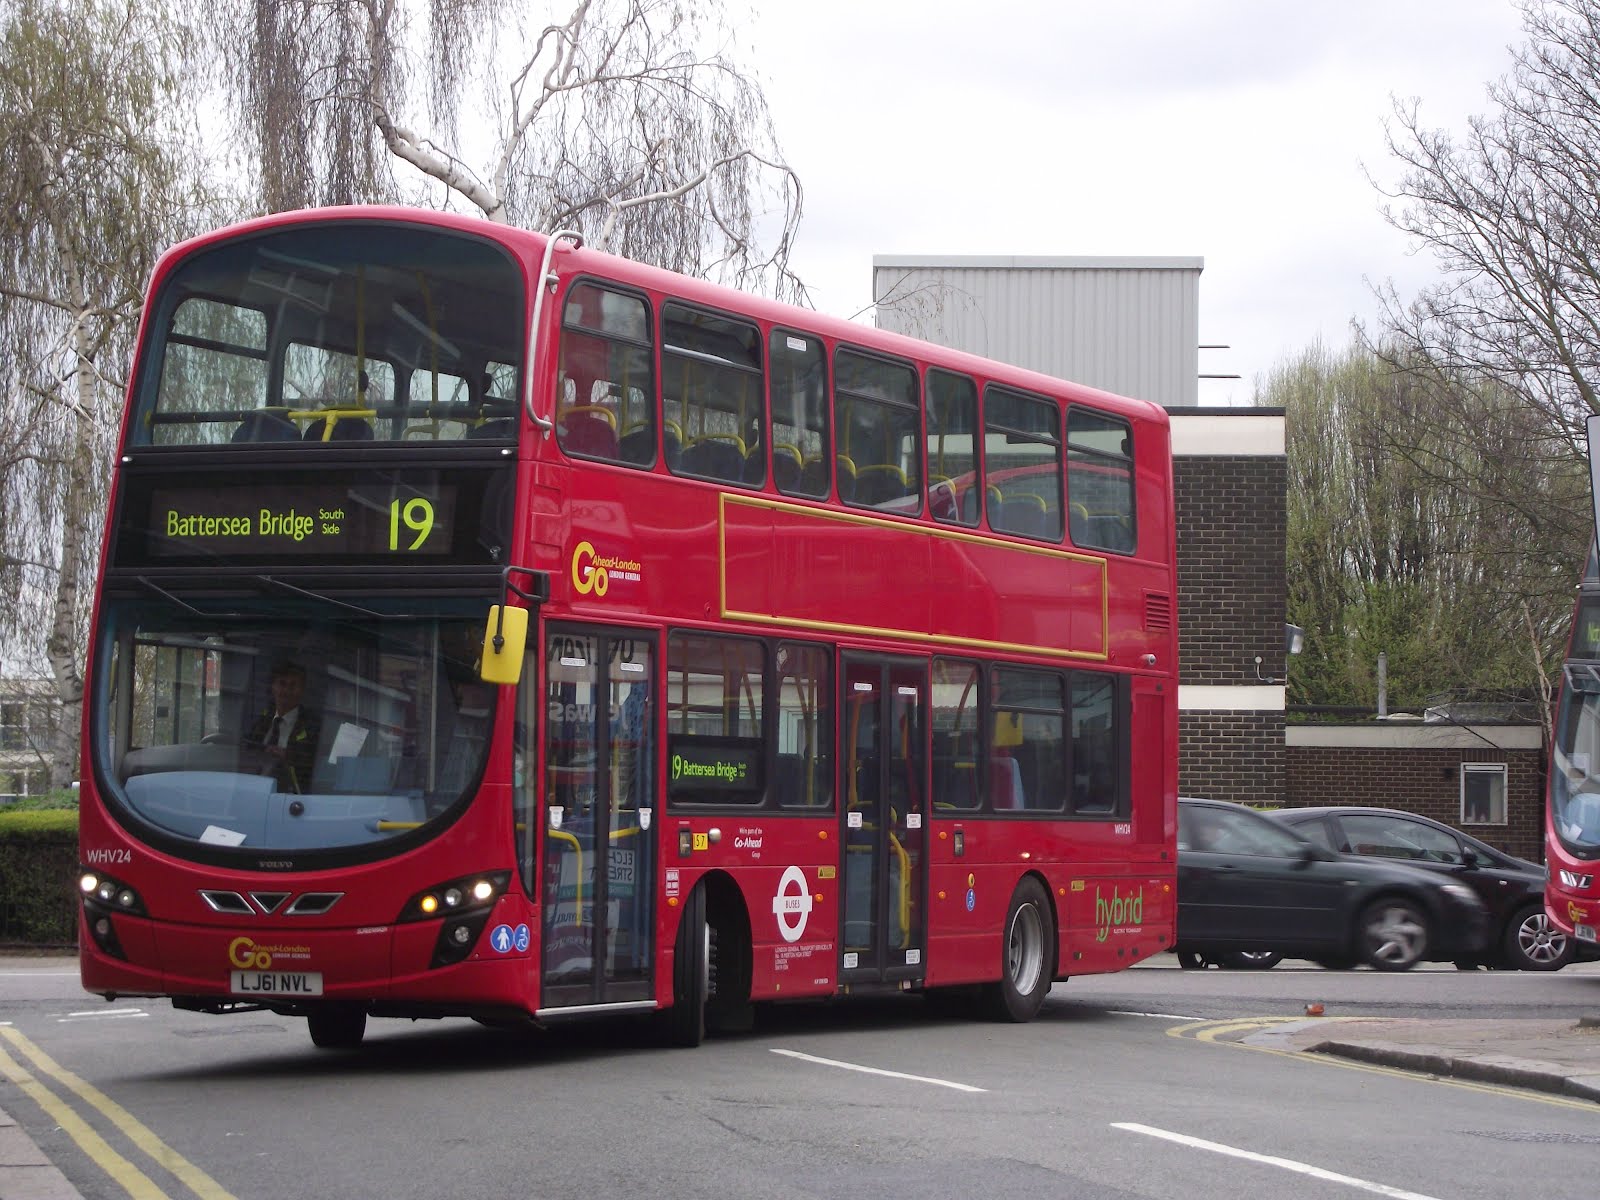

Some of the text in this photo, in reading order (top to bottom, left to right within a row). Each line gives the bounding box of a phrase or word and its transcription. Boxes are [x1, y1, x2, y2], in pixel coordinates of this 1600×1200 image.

[318, 508, 345, 520] South
[167, 509, 314, 541] Battersea Bridge
[321, 523, 341, 534] Side
[389, 497, 435, 551] 19
[572, 541, 609, 597] Go
[592, 555, 641, 571] Ahead-London
[672, 755, 738, 782] 19 Battersea Bridge
[734, 836, 763, 848] Go-Ahead
[87, 849, 132, 864] WHV24
[785, 899, 800, 909] BUSES
[1096, 885, 1143, 942] hybrid
[229, 936, 272, 970] Go
[252, 944, 311, 953] Ahead-London
[241, 974, 312, 992] LJ61 NVL
